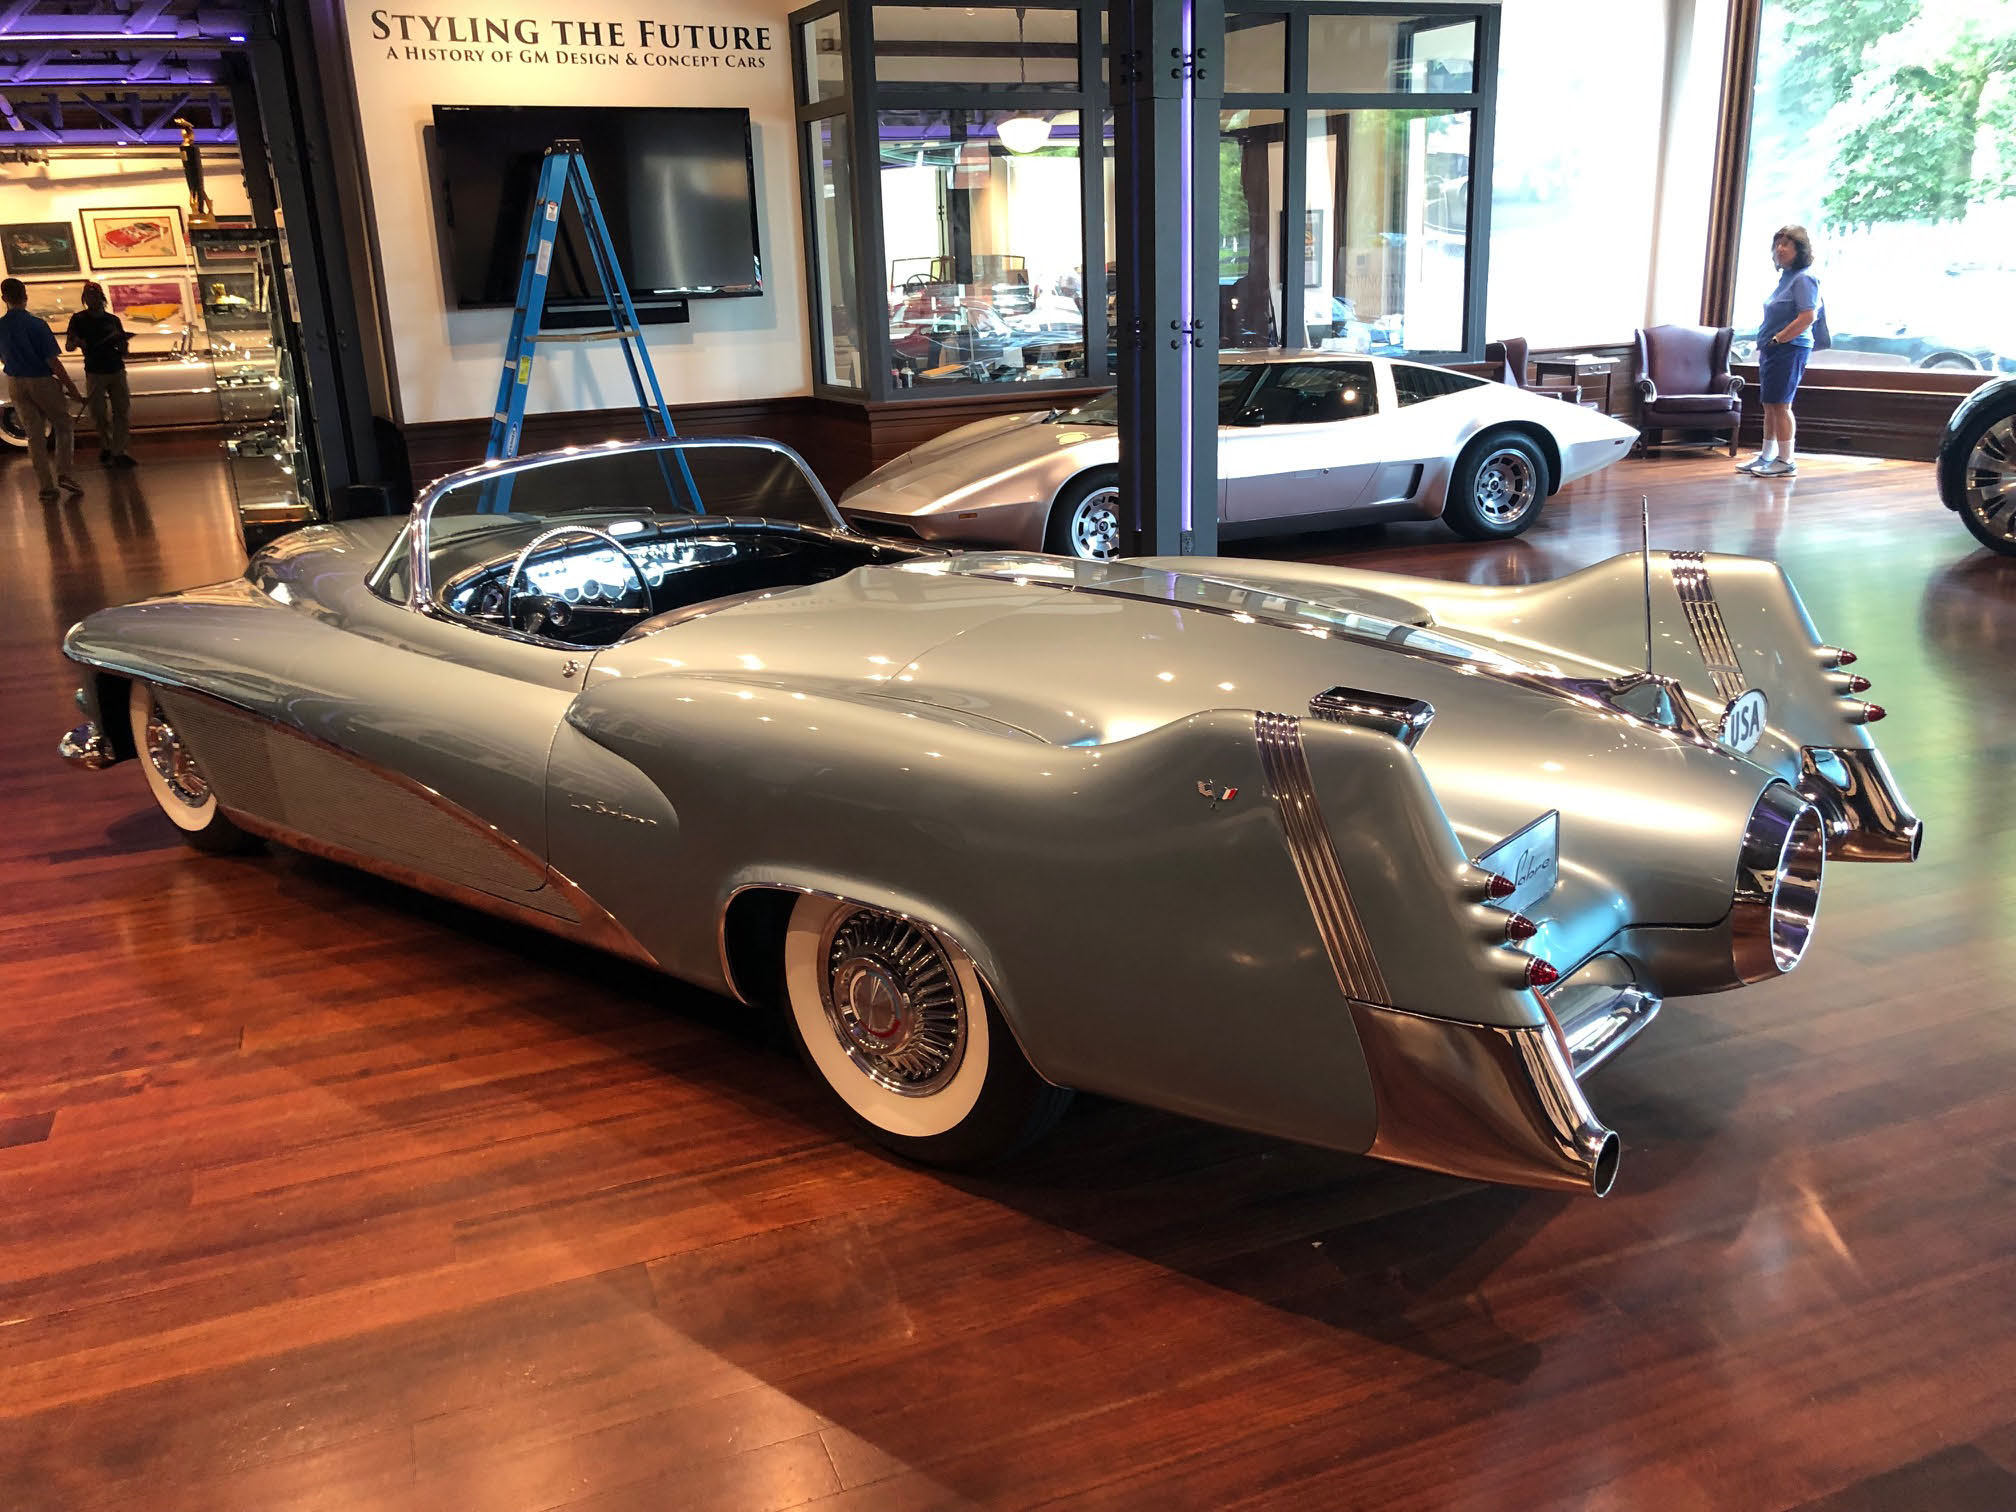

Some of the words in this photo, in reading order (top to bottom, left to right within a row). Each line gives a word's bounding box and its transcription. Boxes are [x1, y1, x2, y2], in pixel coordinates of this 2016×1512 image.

[371, 9, 539, 45] STYLING
[551, 20, 625, 47] THE
[637, 20, 771, 50] FUTURE
[386, 46, 399, 60] A
[405, 46, 485, 63] HISTORY
[491, 50, 513, 63] OF
[519, 50, 550, 64] GM
[556, 51, 619, 66] DESIGN
[625, 53, 638, 66] &
[644, 53, 719, 68] CONCEPT
[725, 54, 766, 68] CARS
[1730, 700, 1760, 747] USA
